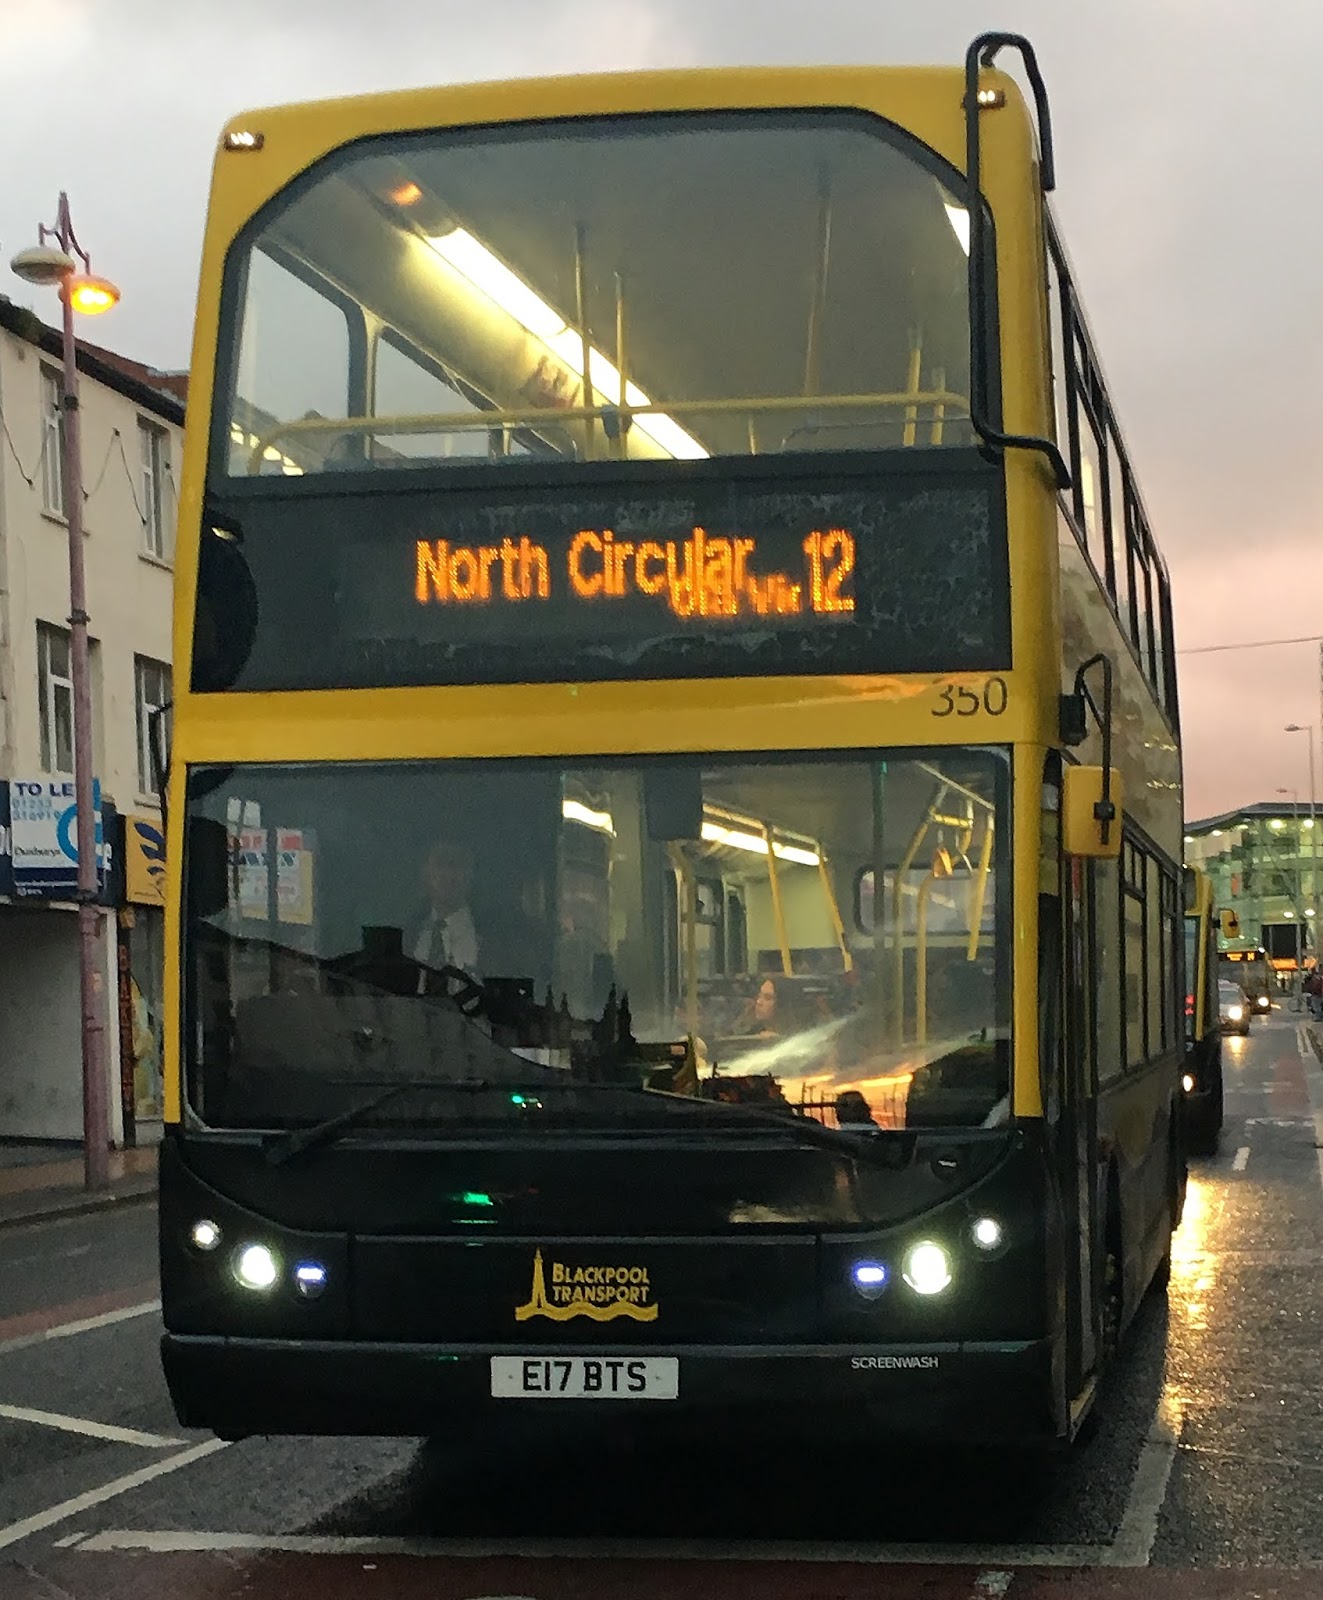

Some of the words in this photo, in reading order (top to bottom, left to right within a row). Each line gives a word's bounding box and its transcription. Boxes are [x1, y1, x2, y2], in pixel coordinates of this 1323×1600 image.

[416, 535, 551, 601] North
[567, 526, 755, 615] Circular
[803, 529, 857, 612] 12
[931, 676, 1008, 717] 350
[14, 782, 43, 797] TO
[49, 782, 75, 797] LE
[552, 1262, 650, 1283] BLACKPOOL
[552, 1286, 650, 1303] TRANSPORT
[851, 1356, 939, 1369] SCREENWASH
[522, 1360, 573, 1392] E17
[583, 1361, 647, 1392] BTS
